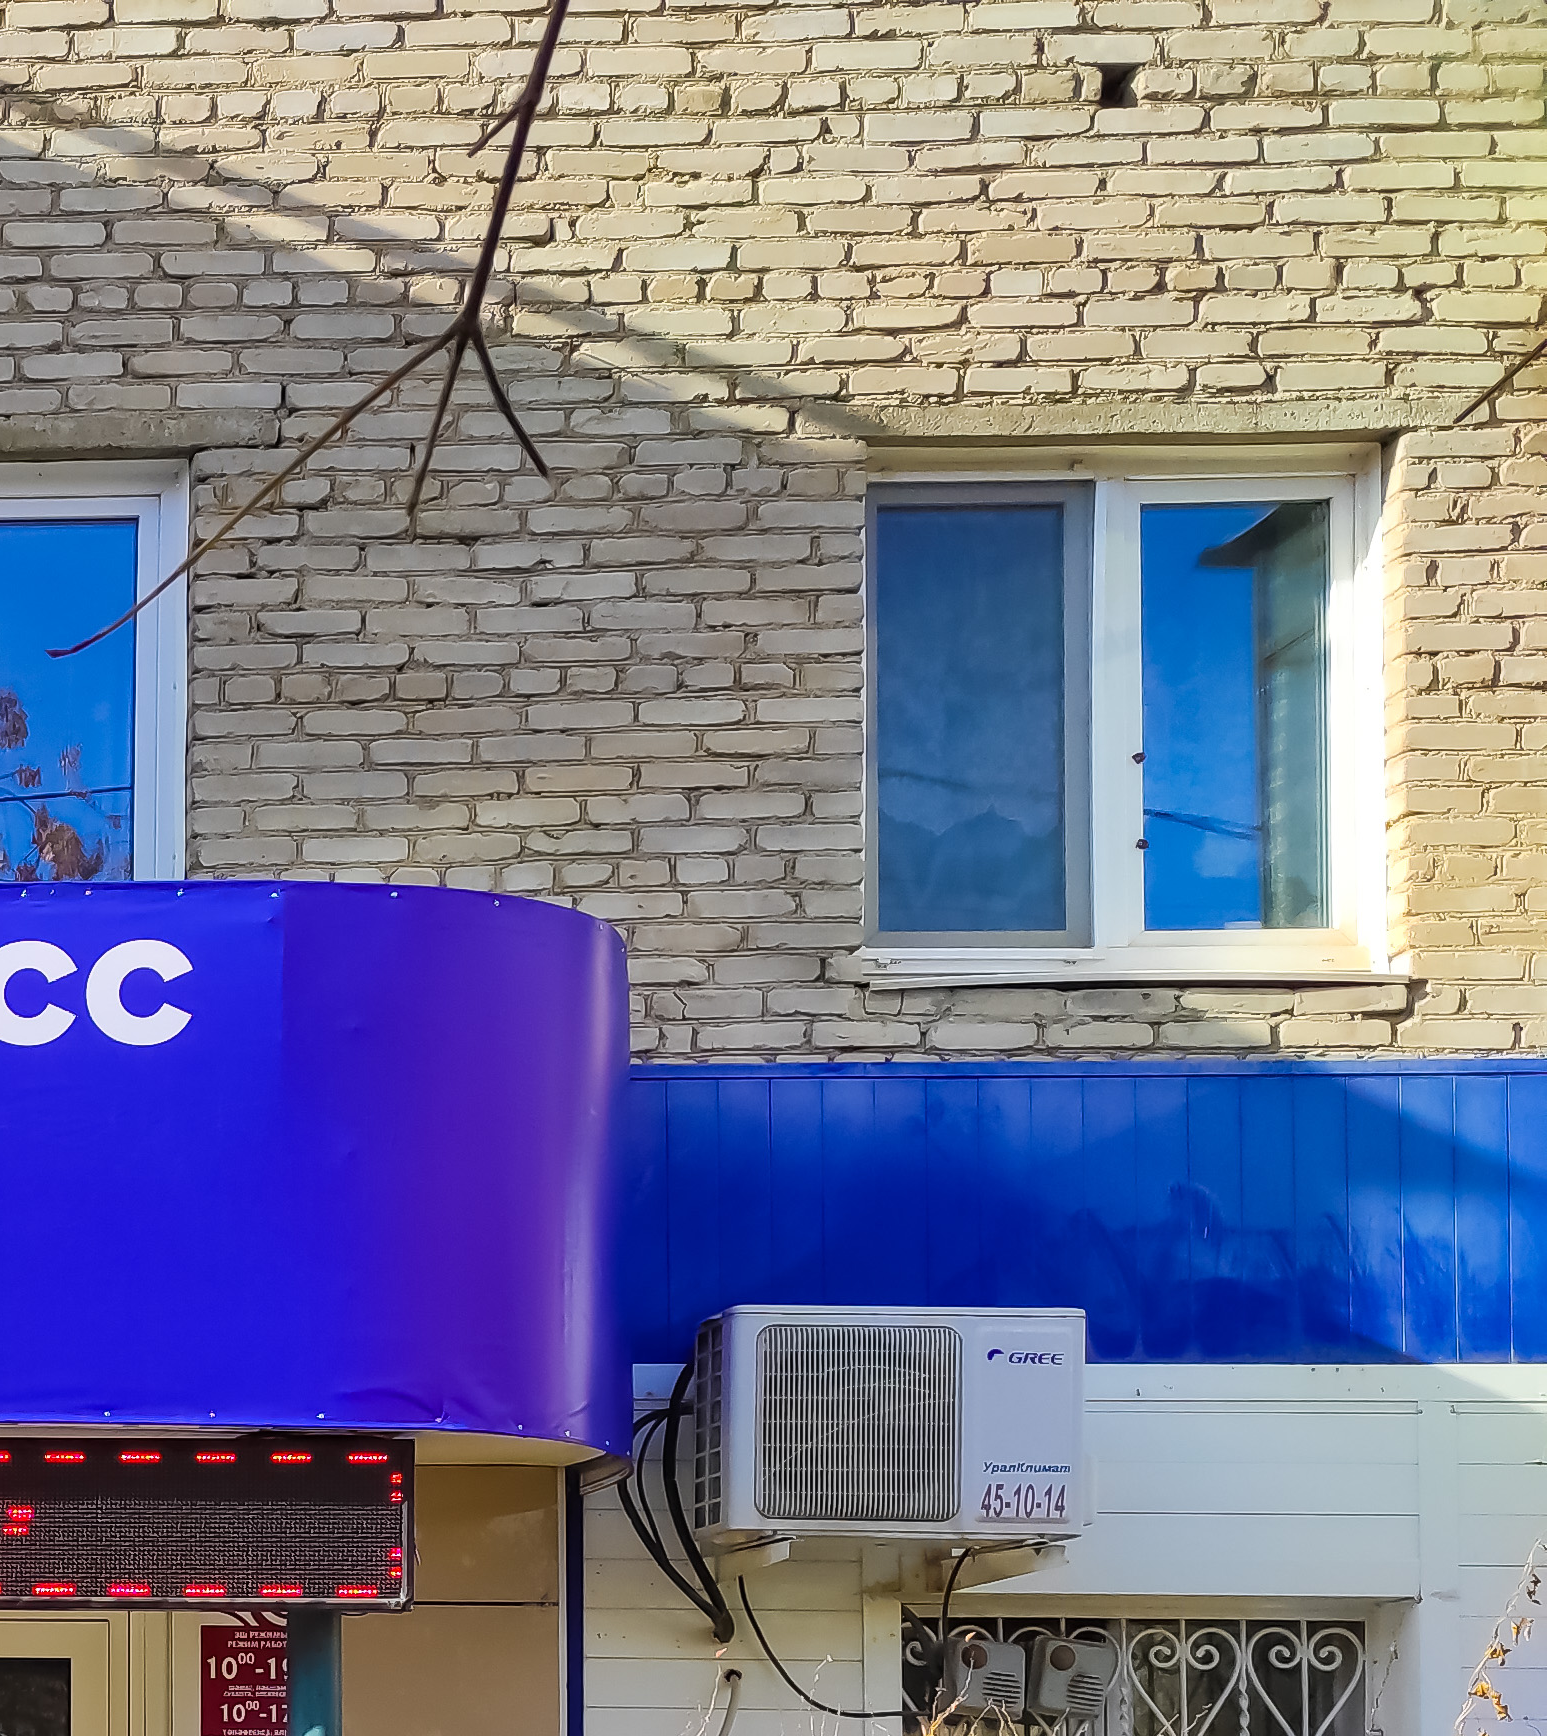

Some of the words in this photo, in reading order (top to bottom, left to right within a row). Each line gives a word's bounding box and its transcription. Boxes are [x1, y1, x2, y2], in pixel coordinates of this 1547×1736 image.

[1008, 1352, 1065, 1365] GREE
[982, 1461, 1071, 1475] УралКлимат
[980, 1483, 1066, 1518] 45-10-14
[260, 1640, 288, 1650] РАБОТ
